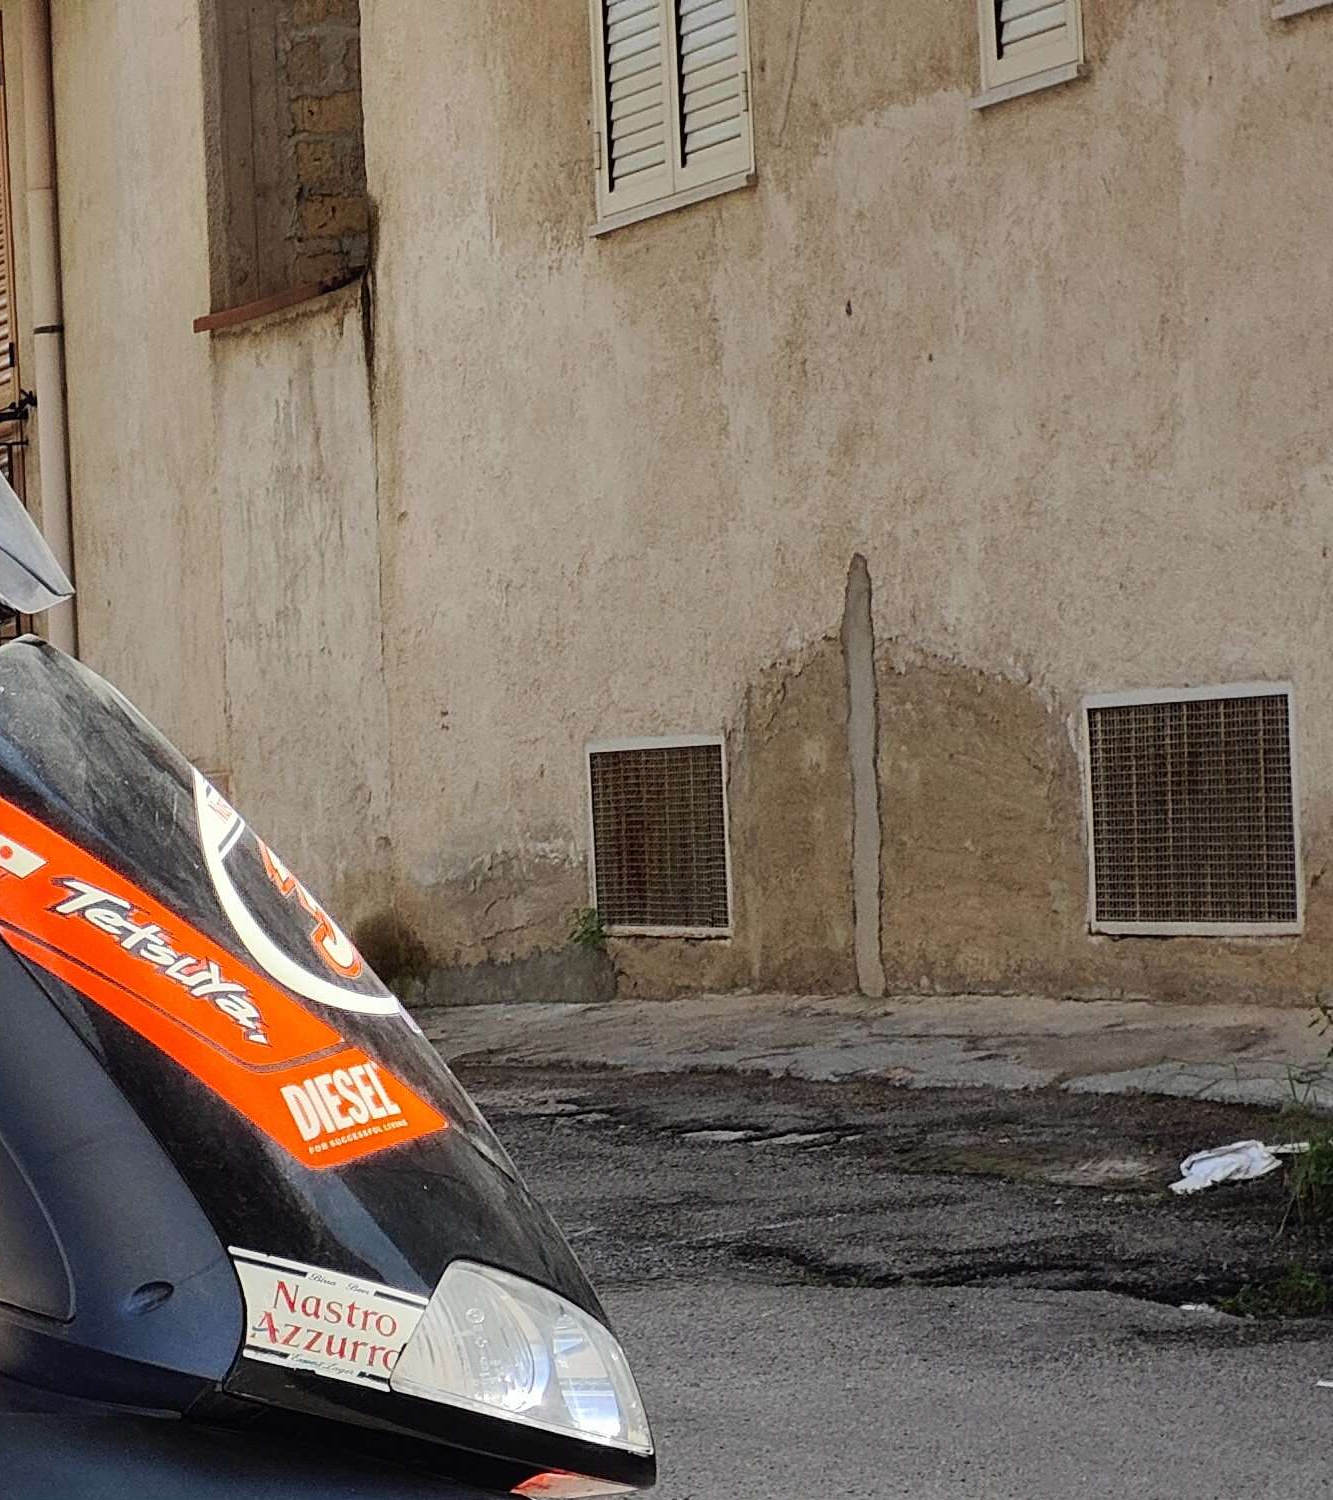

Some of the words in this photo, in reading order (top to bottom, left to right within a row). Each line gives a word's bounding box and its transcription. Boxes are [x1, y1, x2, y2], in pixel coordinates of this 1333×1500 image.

[280, 1062, 402, 1142] DIESEL
[308, 1143, 329, 1155] FOR
[273, 1279, 398, 1338] Nastro
[252, 1310, 402, 1372] Azzurro
